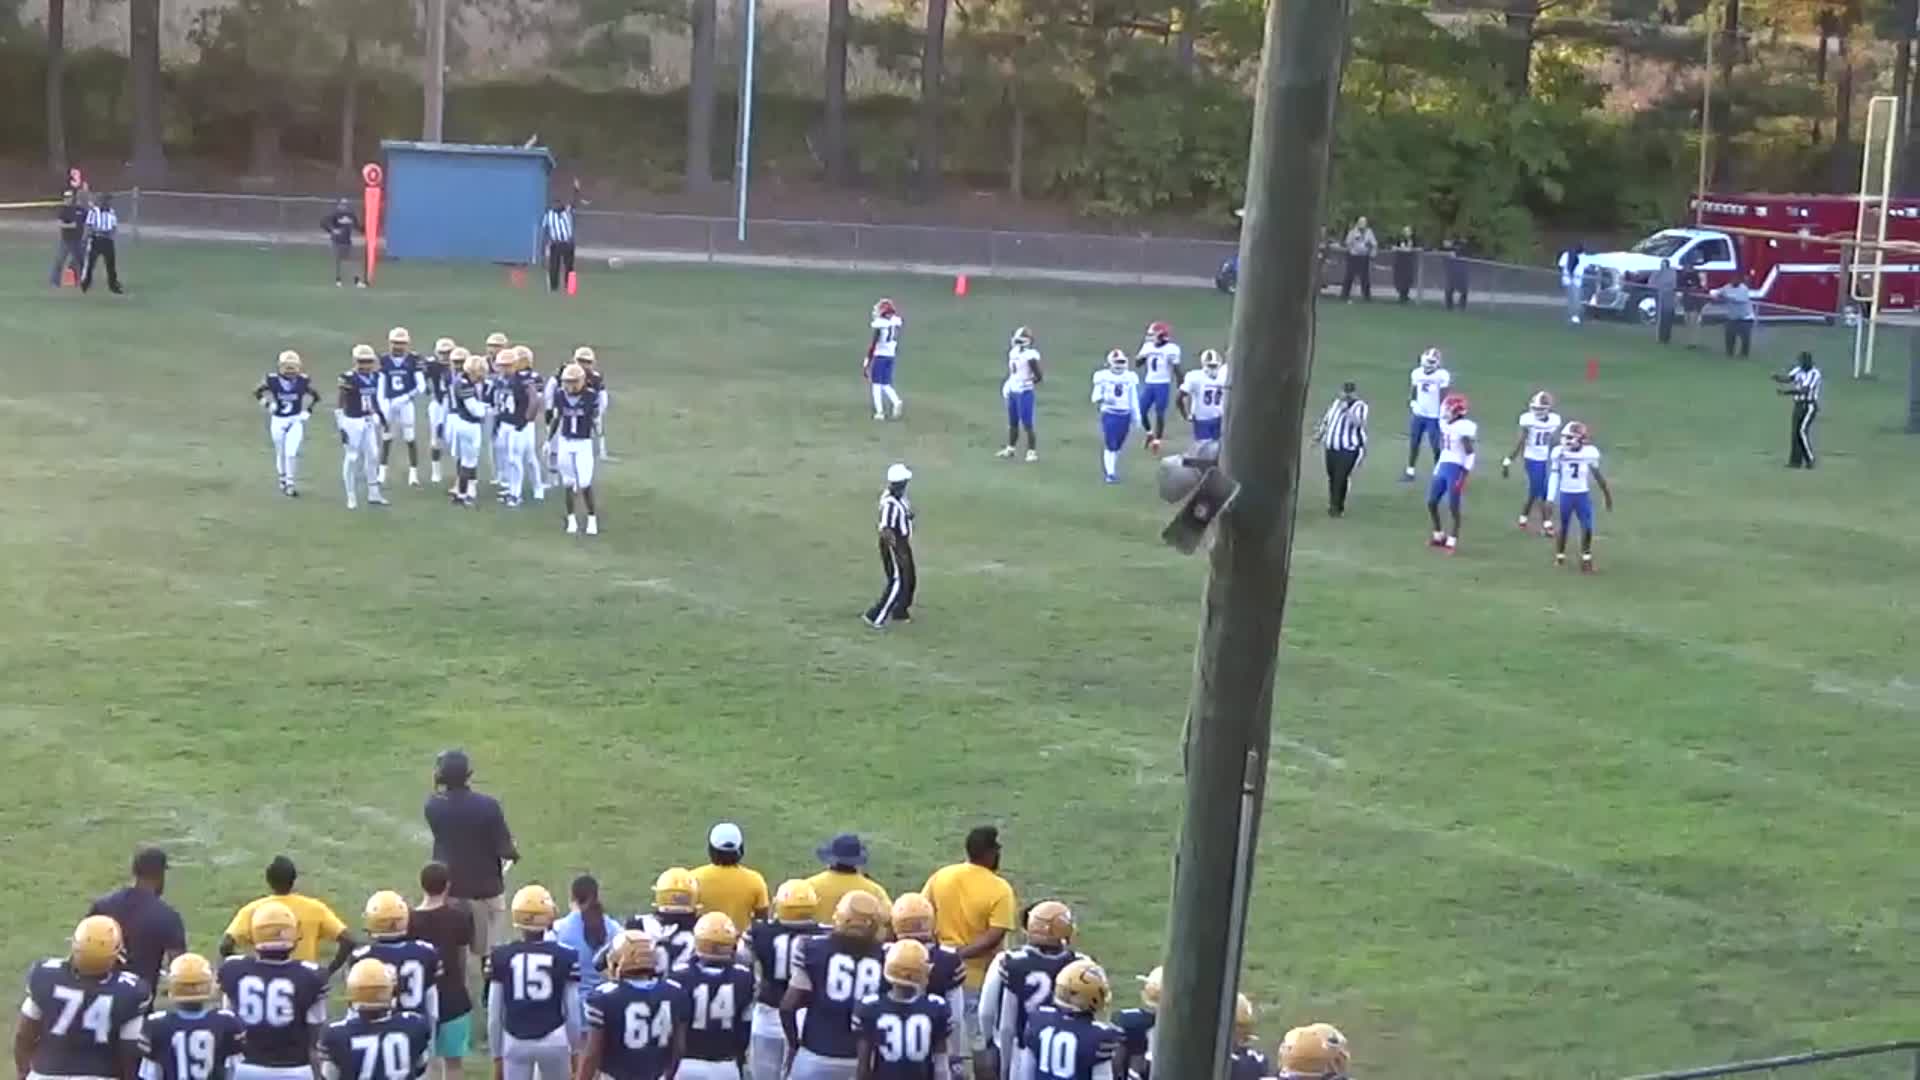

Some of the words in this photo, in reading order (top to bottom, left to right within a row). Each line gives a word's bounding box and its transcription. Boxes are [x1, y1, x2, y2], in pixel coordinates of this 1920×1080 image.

[70, 168, 81, 187] 3
[238, 975, 296, 1026] 66
[397, 959, 425, 1008] 3
[510, 953, 554, 1001] 15
[827, 954, 882, 1002] 68
[52, 985, 113, 1044] 74
[624, 1000, 673, 1049] 64
[692, 983, 735, 1030] 14
[171, 1030, 215, 1080] 19
[350, 1032, 411, 1080] 70
[877, 1016, 932, 1062] 30
[1038, 1026, 1078, 1078] 10
